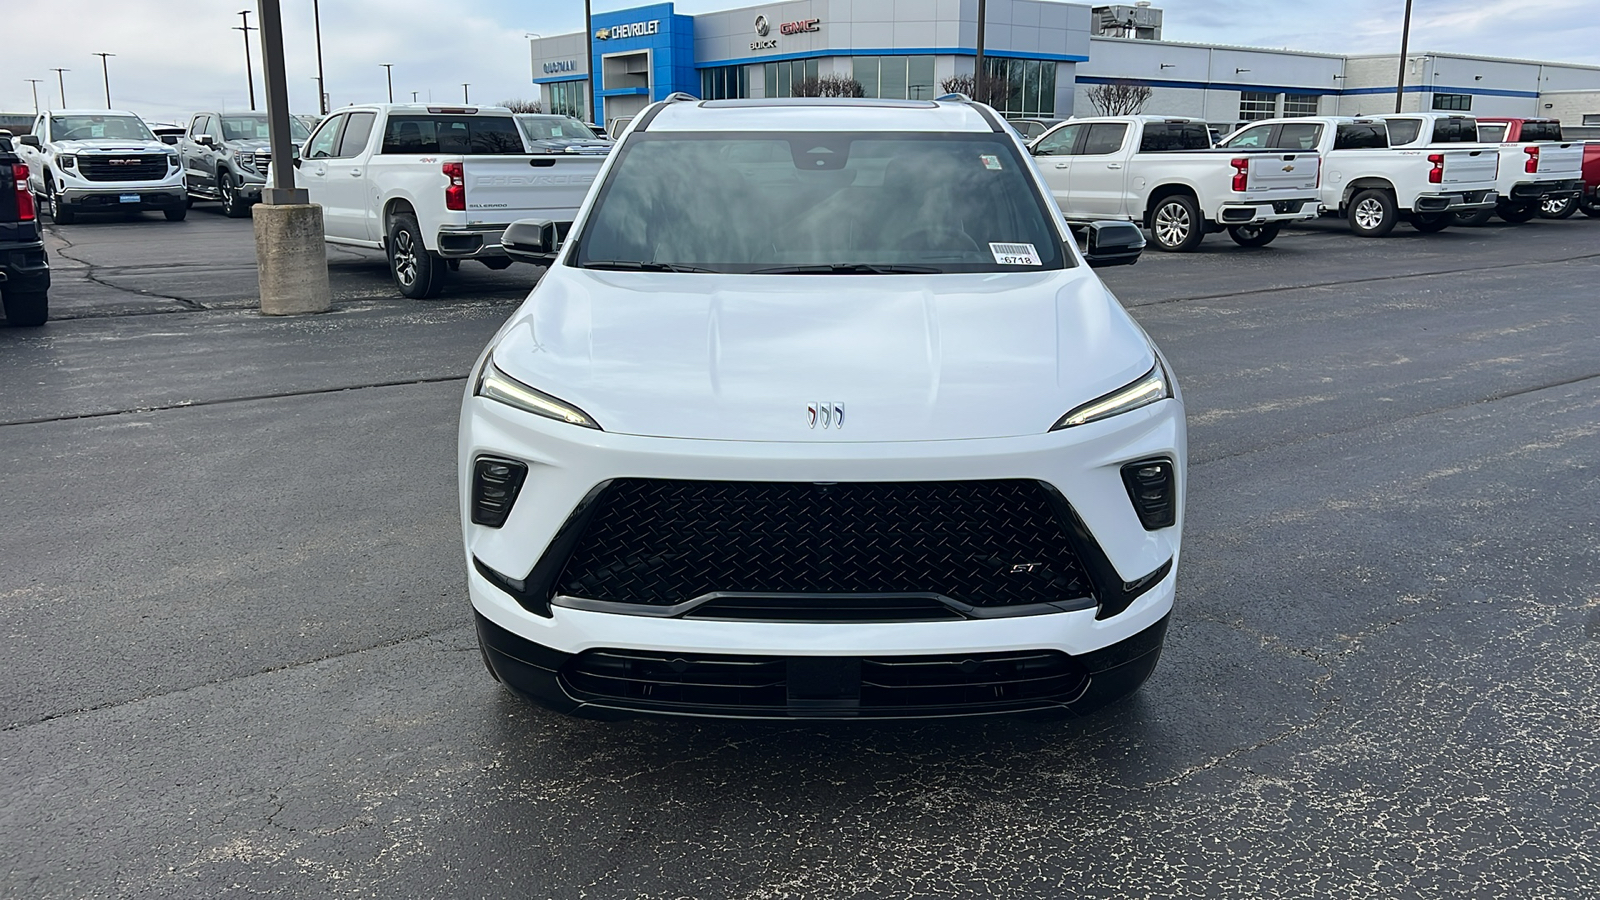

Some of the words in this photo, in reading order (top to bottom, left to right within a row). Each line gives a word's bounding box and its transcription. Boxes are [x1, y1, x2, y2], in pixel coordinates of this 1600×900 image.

[611, 20, 660, 39] CHEVROLET
[780, 19, 820, 35] GMC
[749, 40, 777, 50] BUICK
[477, 175, 596, 186] CHEVROLE
[1004, 256, 1032, 265] 6718
